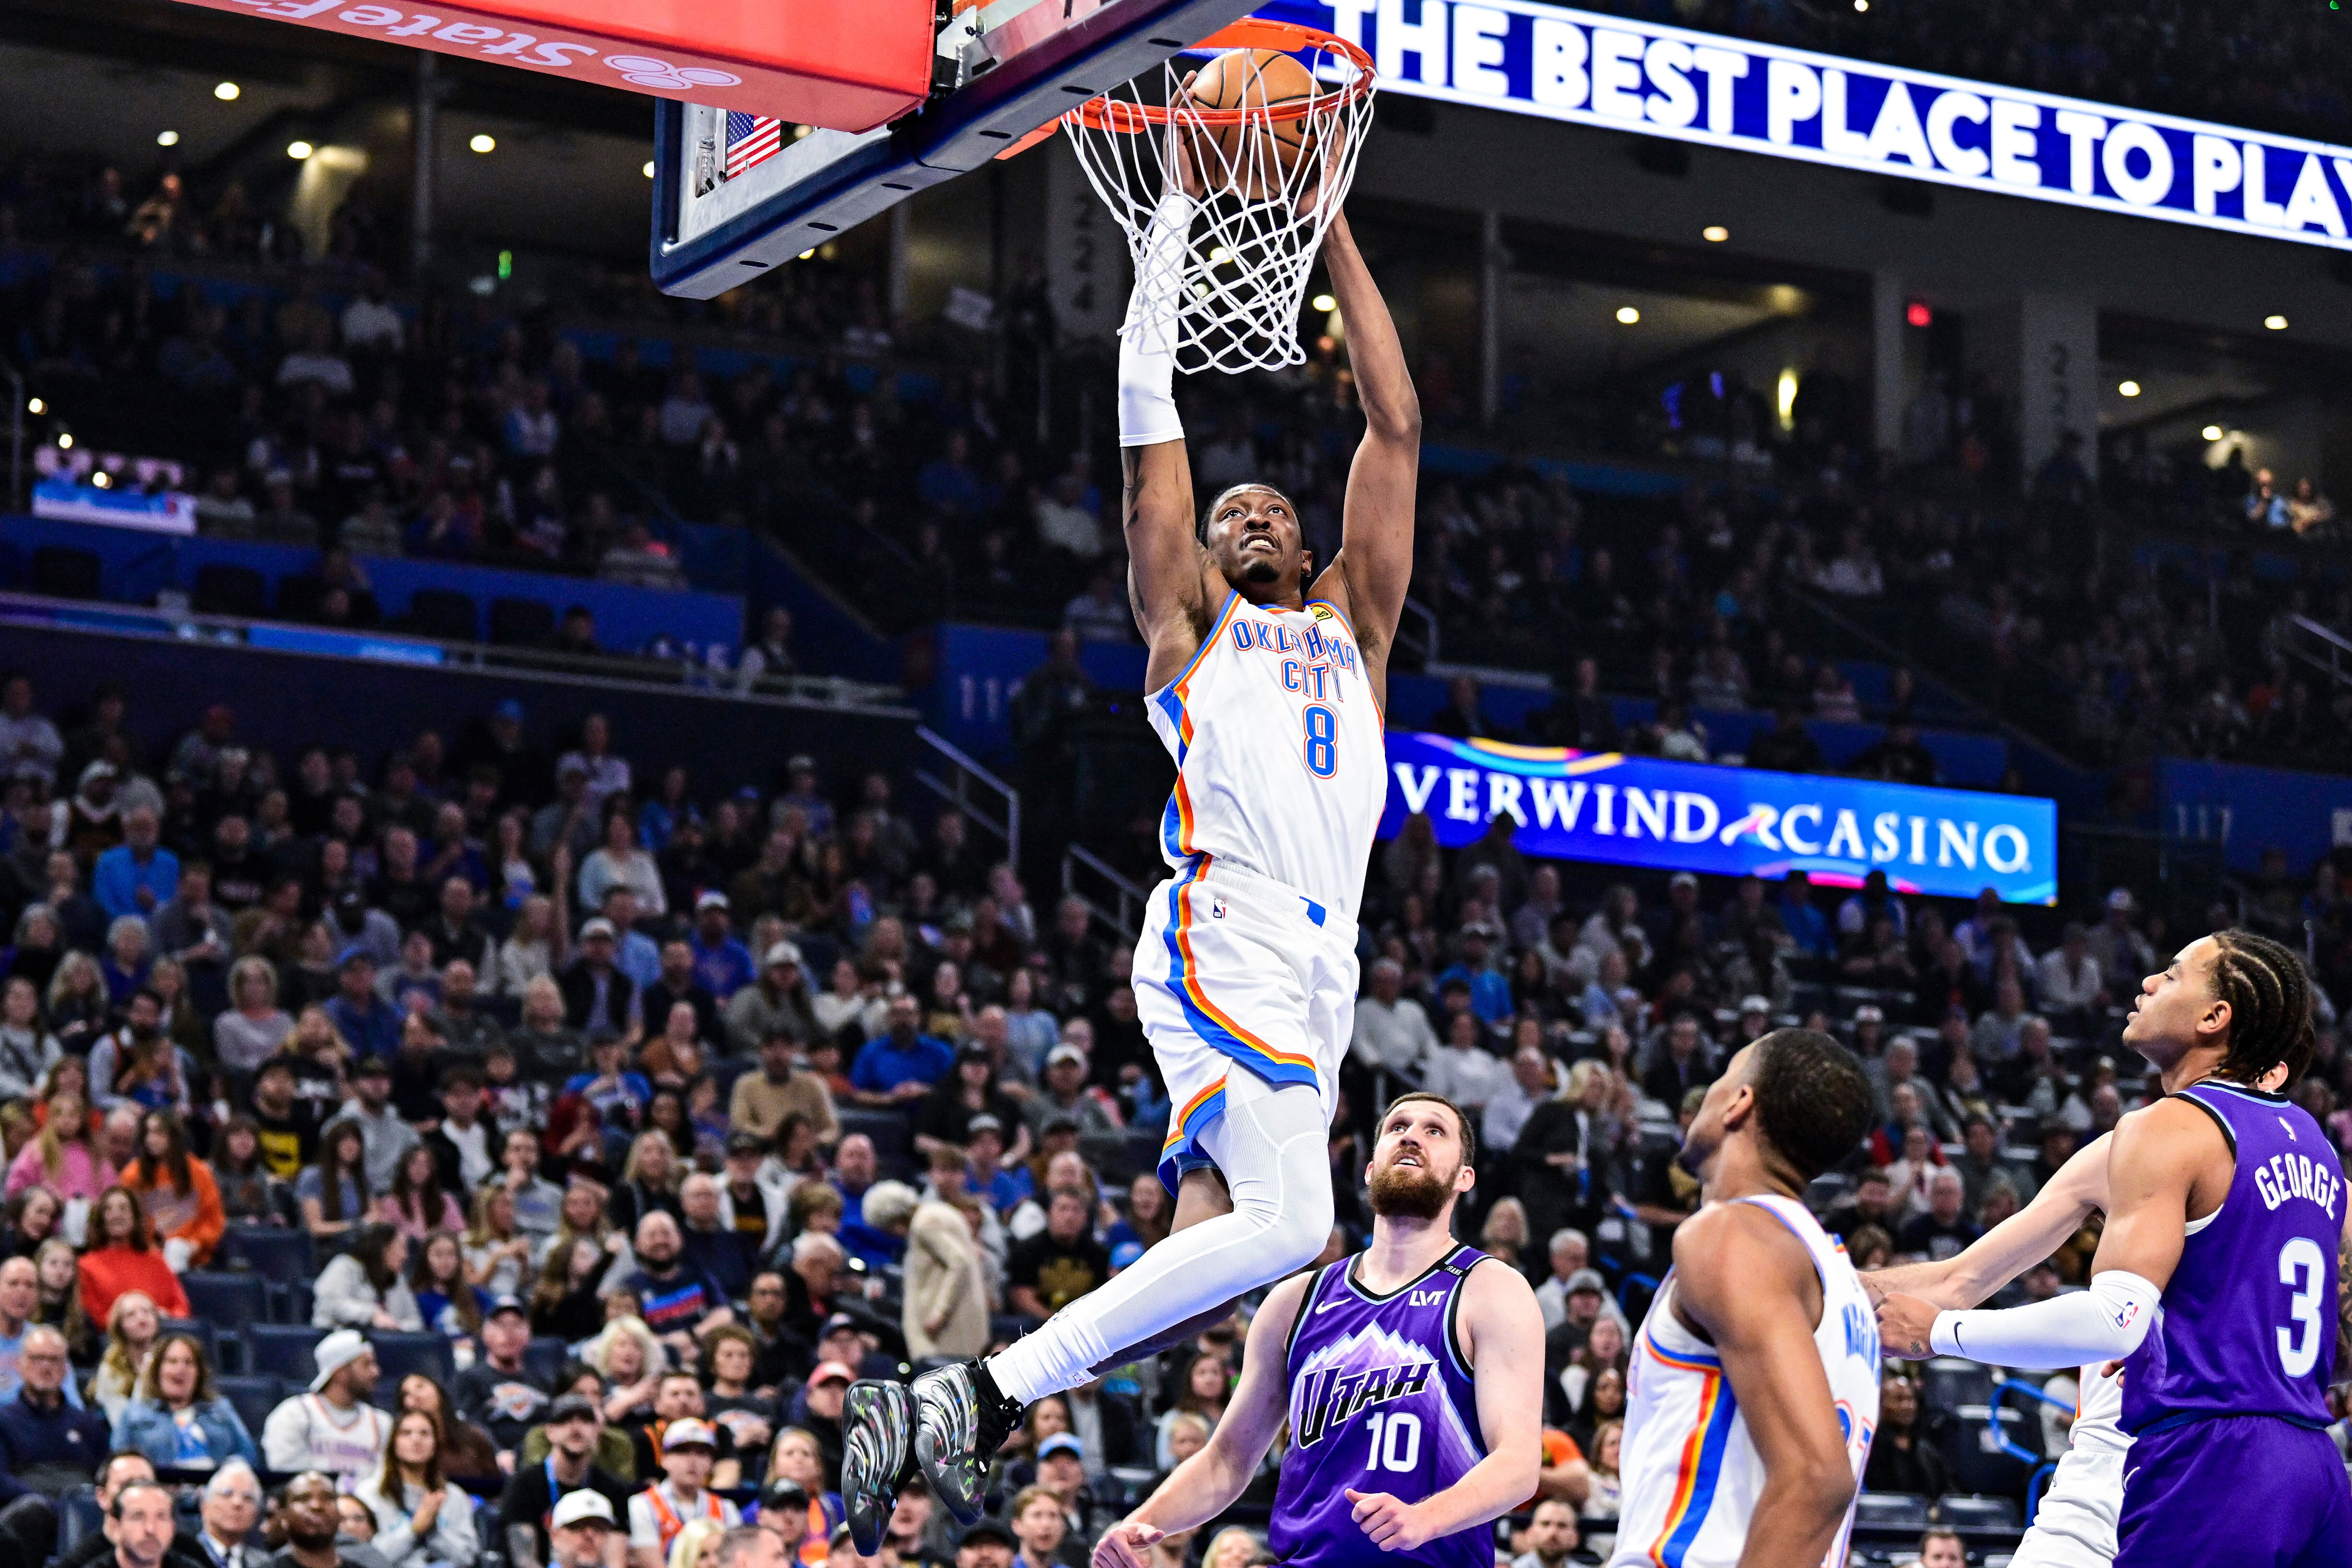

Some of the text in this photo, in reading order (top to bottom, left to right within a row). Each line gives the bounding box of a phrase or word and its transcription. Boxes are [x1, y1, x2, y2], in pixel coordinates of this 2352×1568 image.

[1318, 0, 1510, 96] THE
[1532, 17, 1750, 134] BEST
[1768, 58, 2042, 186] PLACE
[2056, 108, 2174, 205] TO
[1281, 658, 1344, 703] CITY
[1303, 703, 1338, 780] 8
[2254, 1154, 2340, 1221] GEORGE
[1409, 1290, 1447, 1306] LVT
[2276, 1237, 2325, 1378] 3
[1297, 1359, 1439, 1450] UTAH
[1365, 1411, 1421, 1473] 10
